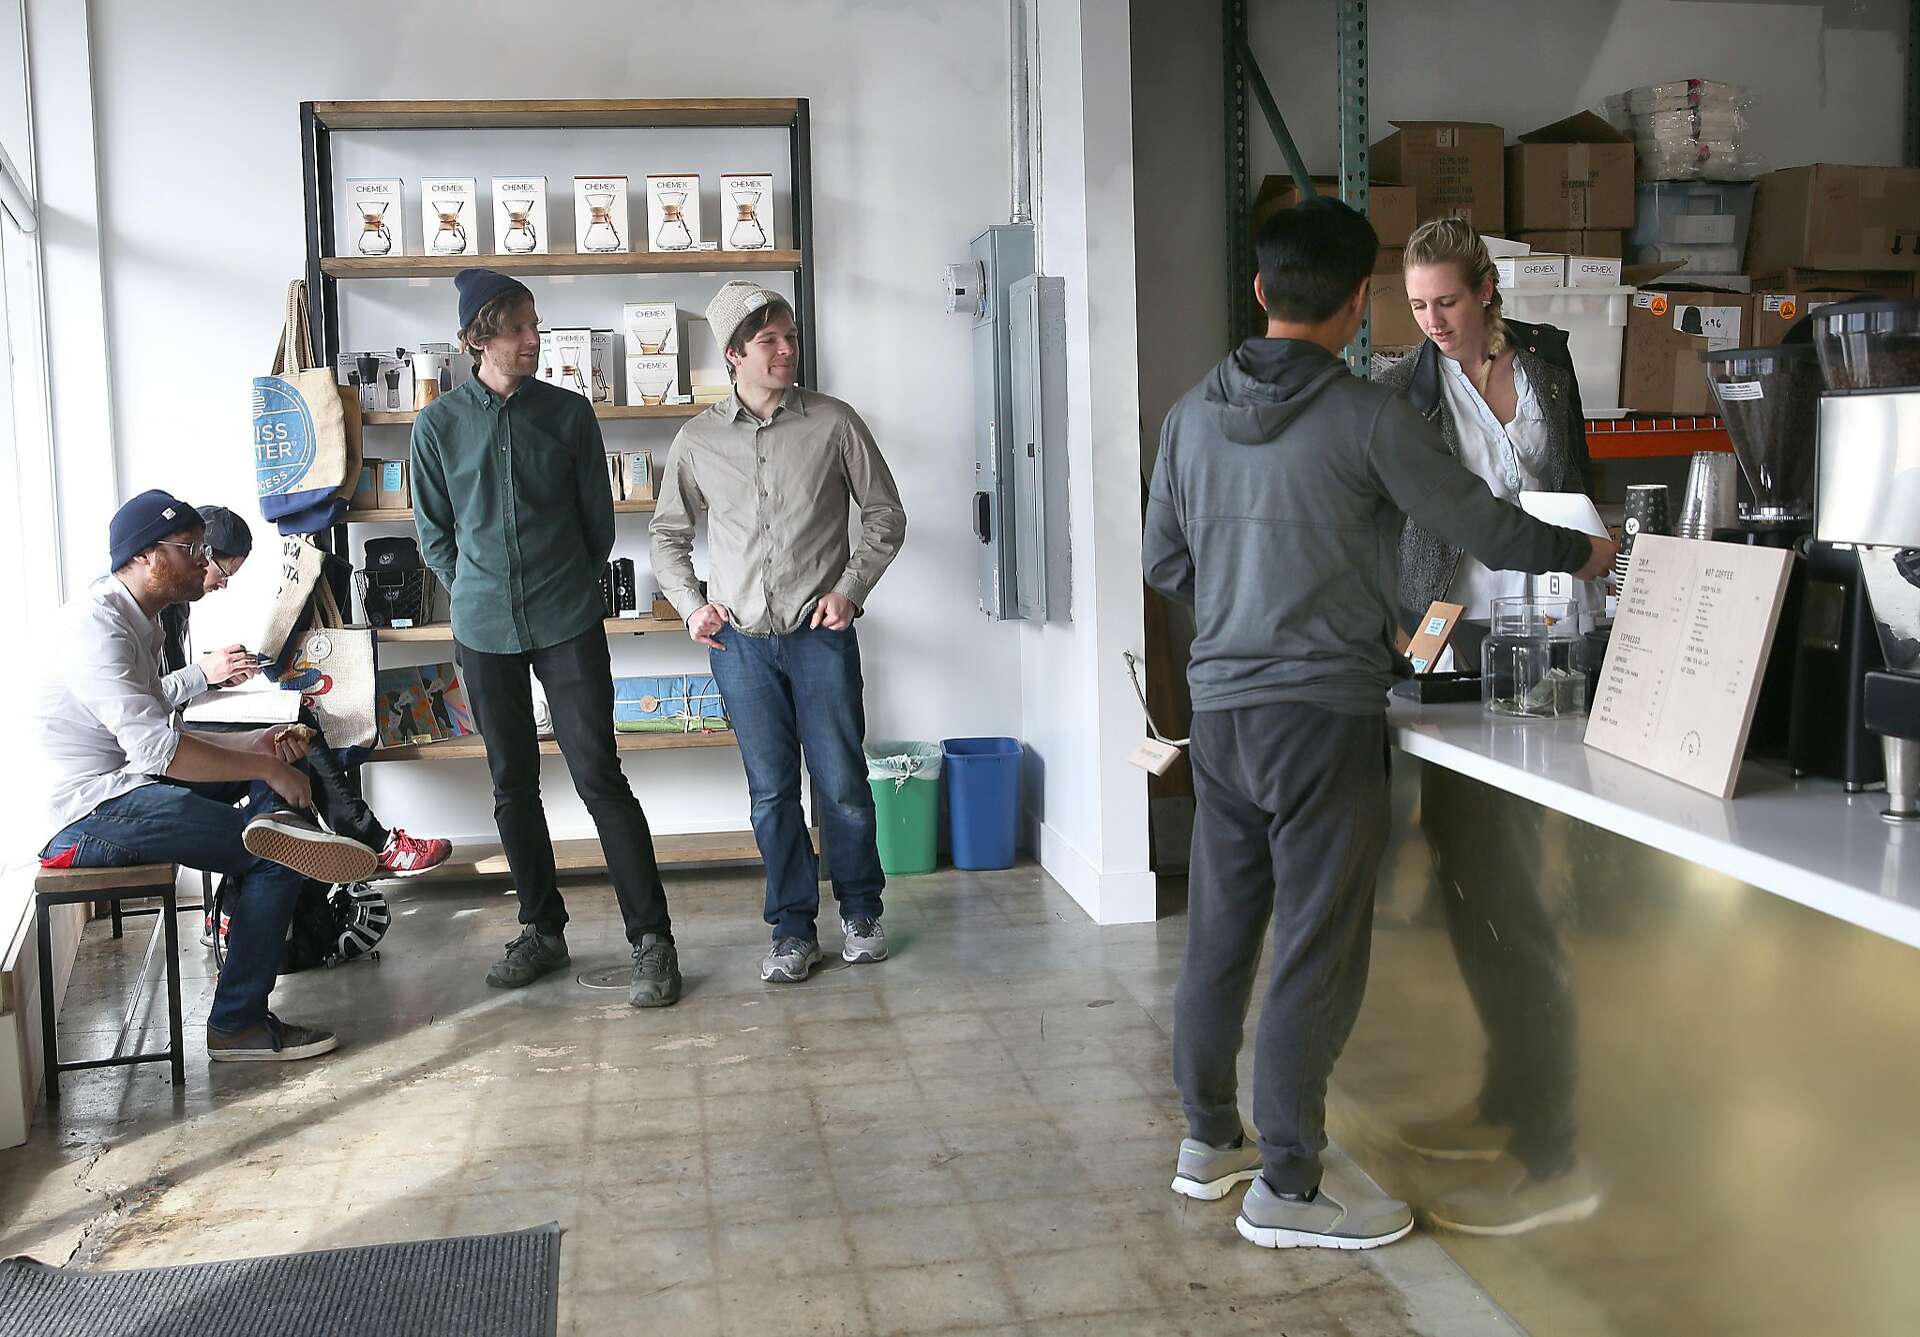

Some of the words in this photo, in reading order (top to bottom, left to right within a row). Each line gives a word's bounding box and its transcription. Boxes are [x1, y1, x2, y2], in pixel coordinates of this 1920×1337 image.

[356, 184, 389, 193] CHEMEX
[431, 184, 464, 192] CHEMEX
[502, 183, 535, 191] CHEMEX
[656, 181, 688, 189] CHEMEX
[1524, 264, 1555, 274] CHEMEX
[1581, 264, 1612, 274] CHEMEX
[635, 310, 667, 318] CHEMEX
[637, 362, 668, 370] CHEMEX
[391, 851, 416, 869] N
